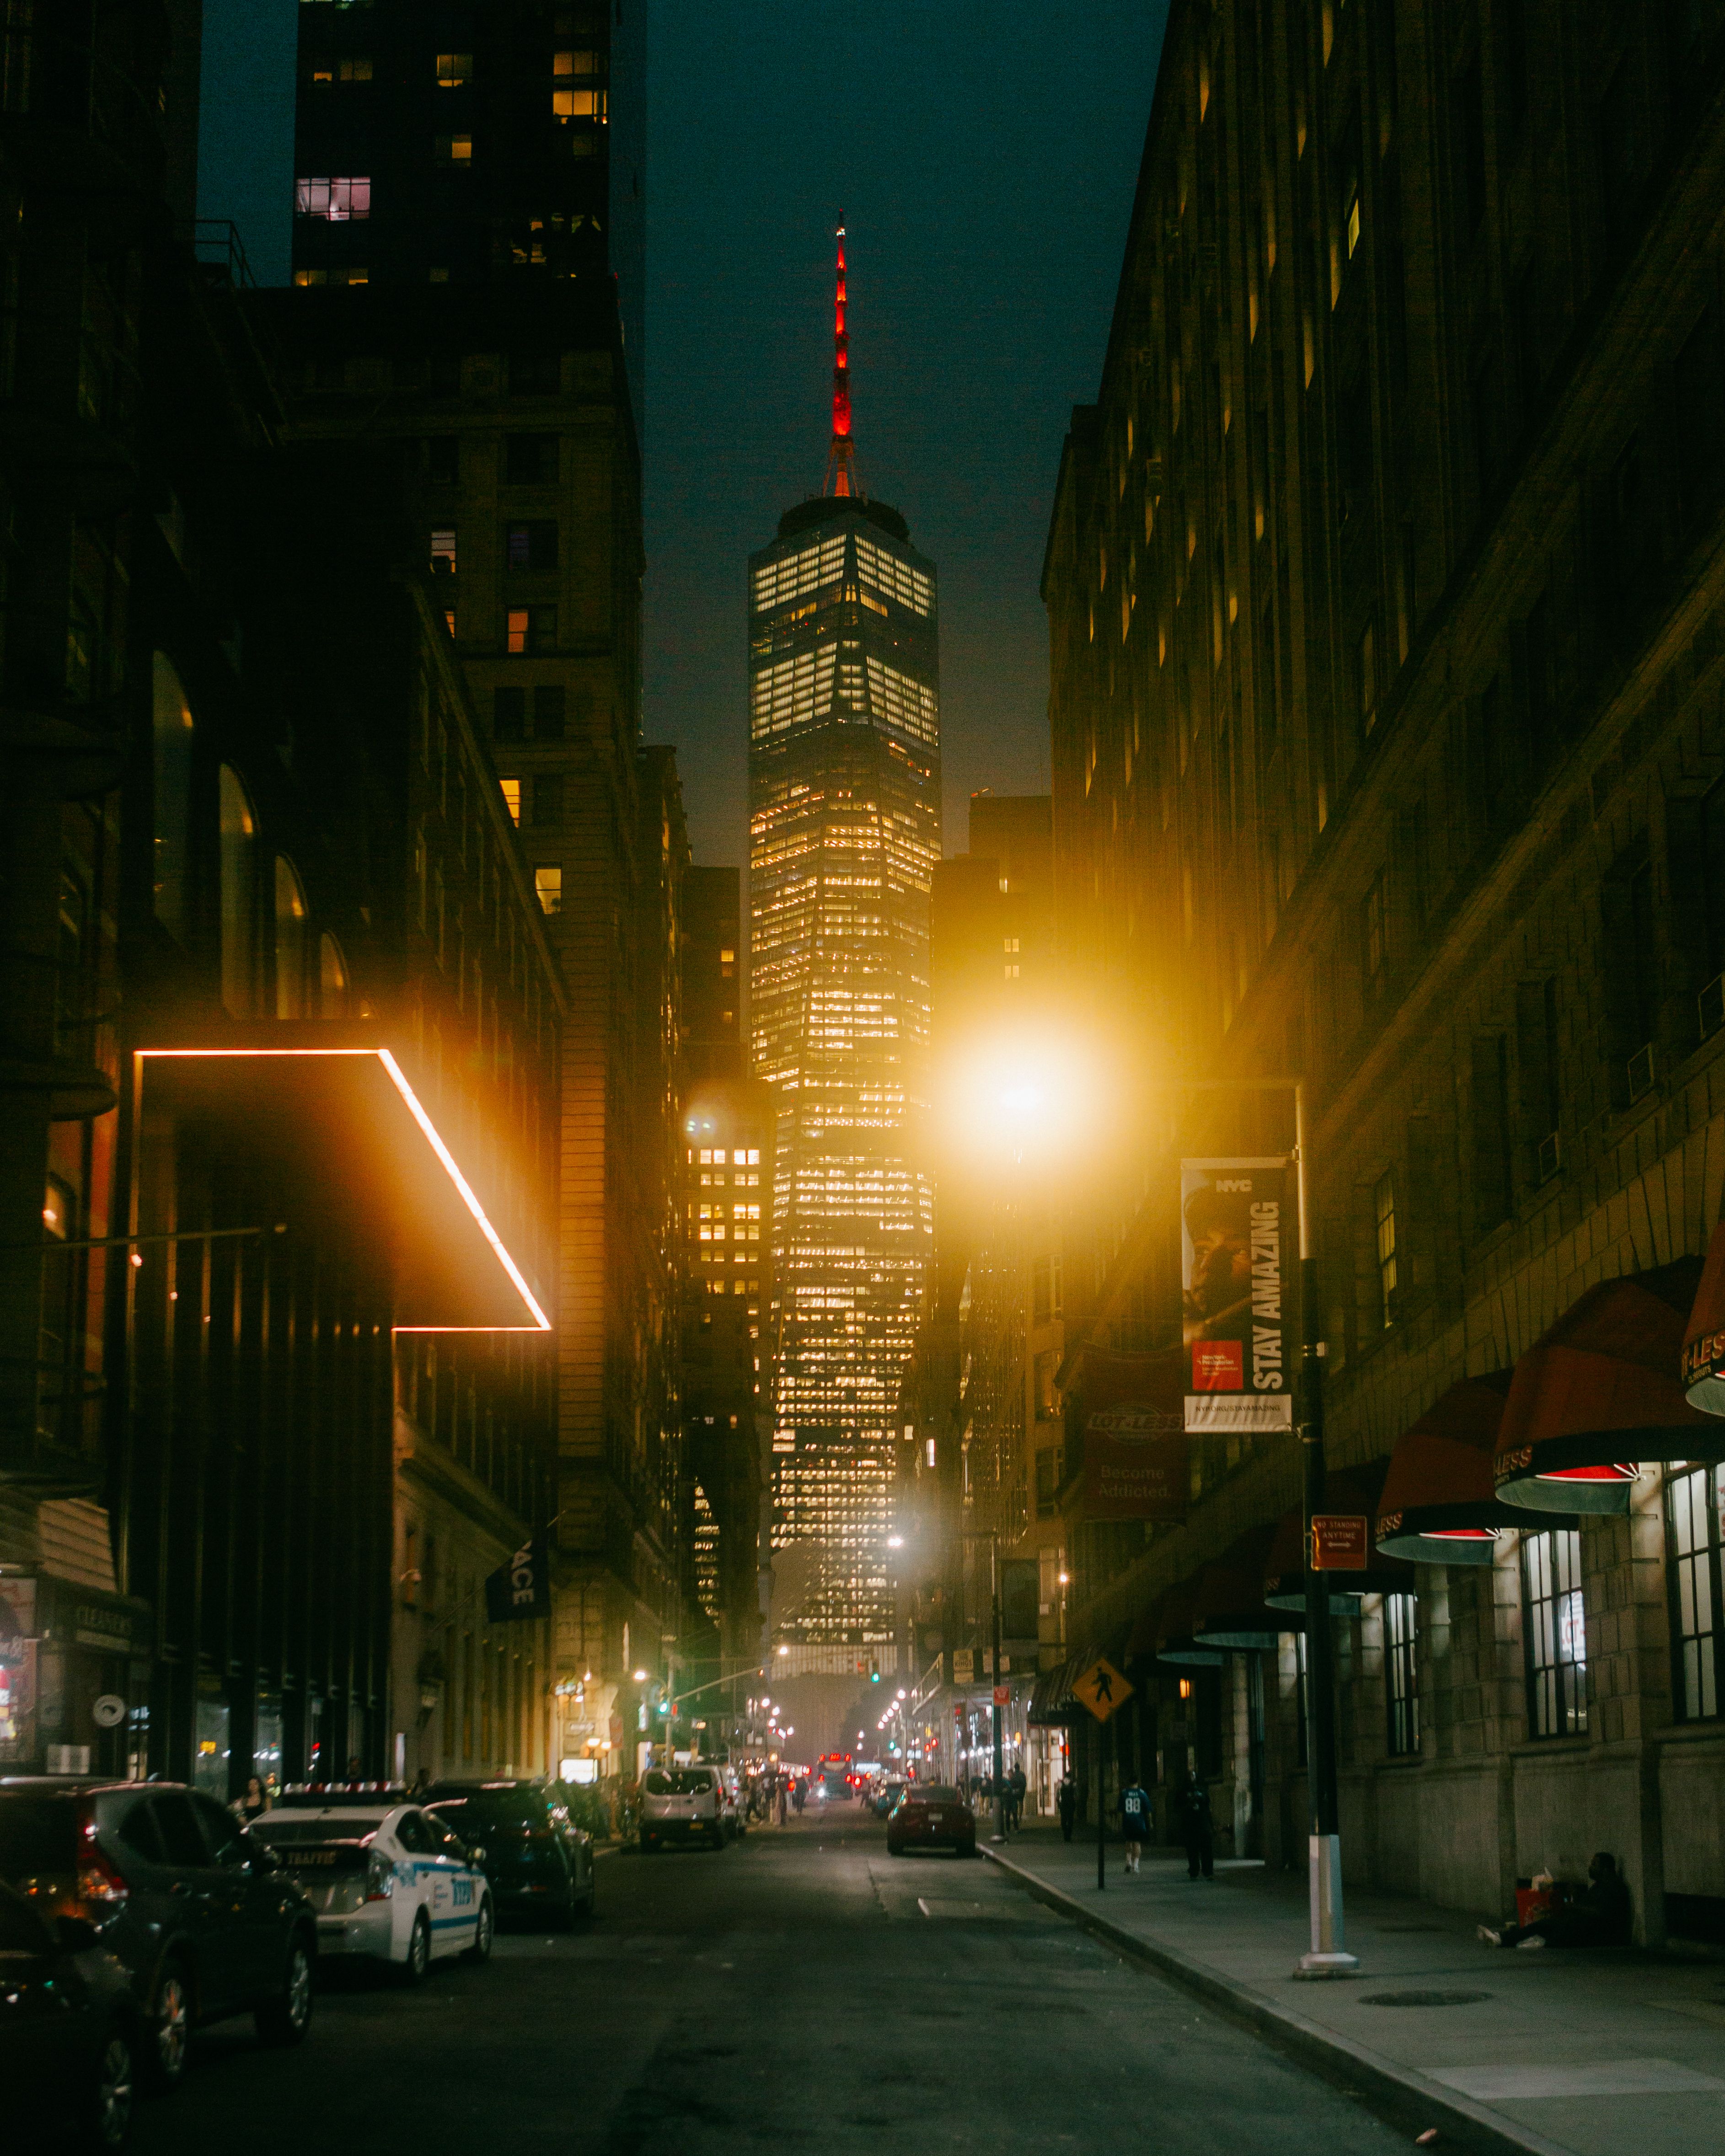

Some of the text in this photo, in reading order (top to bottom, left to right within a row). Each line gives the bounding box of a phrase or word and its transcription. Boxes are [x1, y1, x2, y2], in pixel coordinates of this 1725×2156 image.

[1216, 1179, 1252, 1192] NYC
[1250, 1201, 1283, 1391] STAY AMAZING
[1101, 1465, 1164, 1480] Become
[1323, 1531, 1355, 1540] ANYTIME
[1125, 1798, 1141, 1814] 88
[287, 1850, 337, 1865] TRAFFIC
